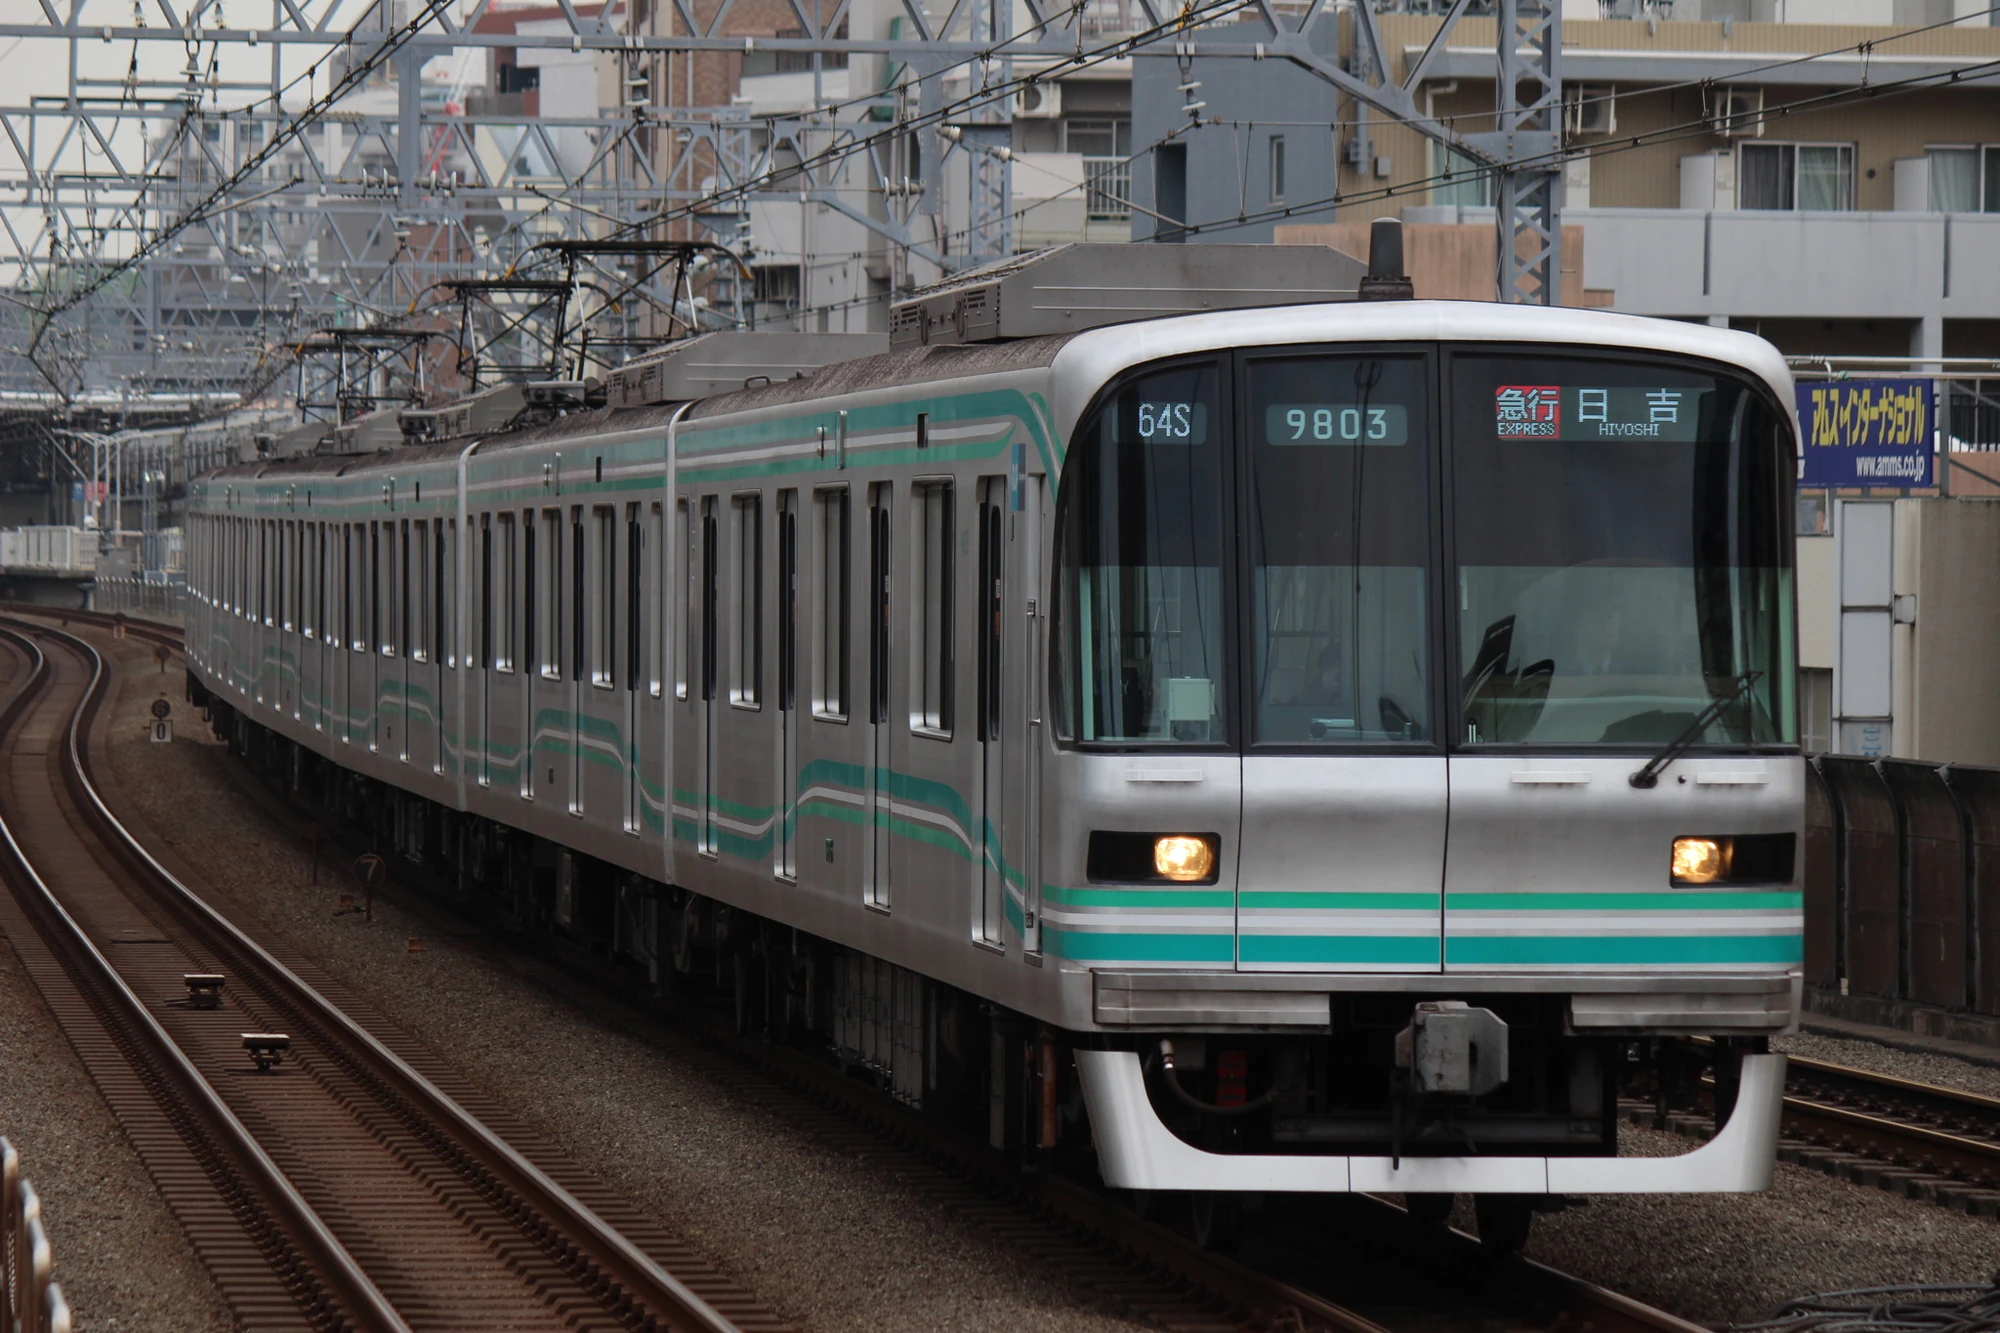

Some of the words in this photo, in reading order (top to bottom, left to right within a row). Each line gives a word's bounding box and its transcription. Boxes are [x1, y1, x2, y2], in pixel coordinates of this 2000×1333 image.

[1138, 403, 1190, 437] 64S
[1496, 388, 1559, 421] 急行
[1578, 388, 1682, 423] 日吉
[1286, 409, 1387, 440] 9803
[1497, 422, 1556, 436] EXPRESS
[1599, 423, 1660, 436] HIYOSHI
[1856, 449, 1925, 482] www.amms.co.jp
[361, 858, 379, 882] 7
